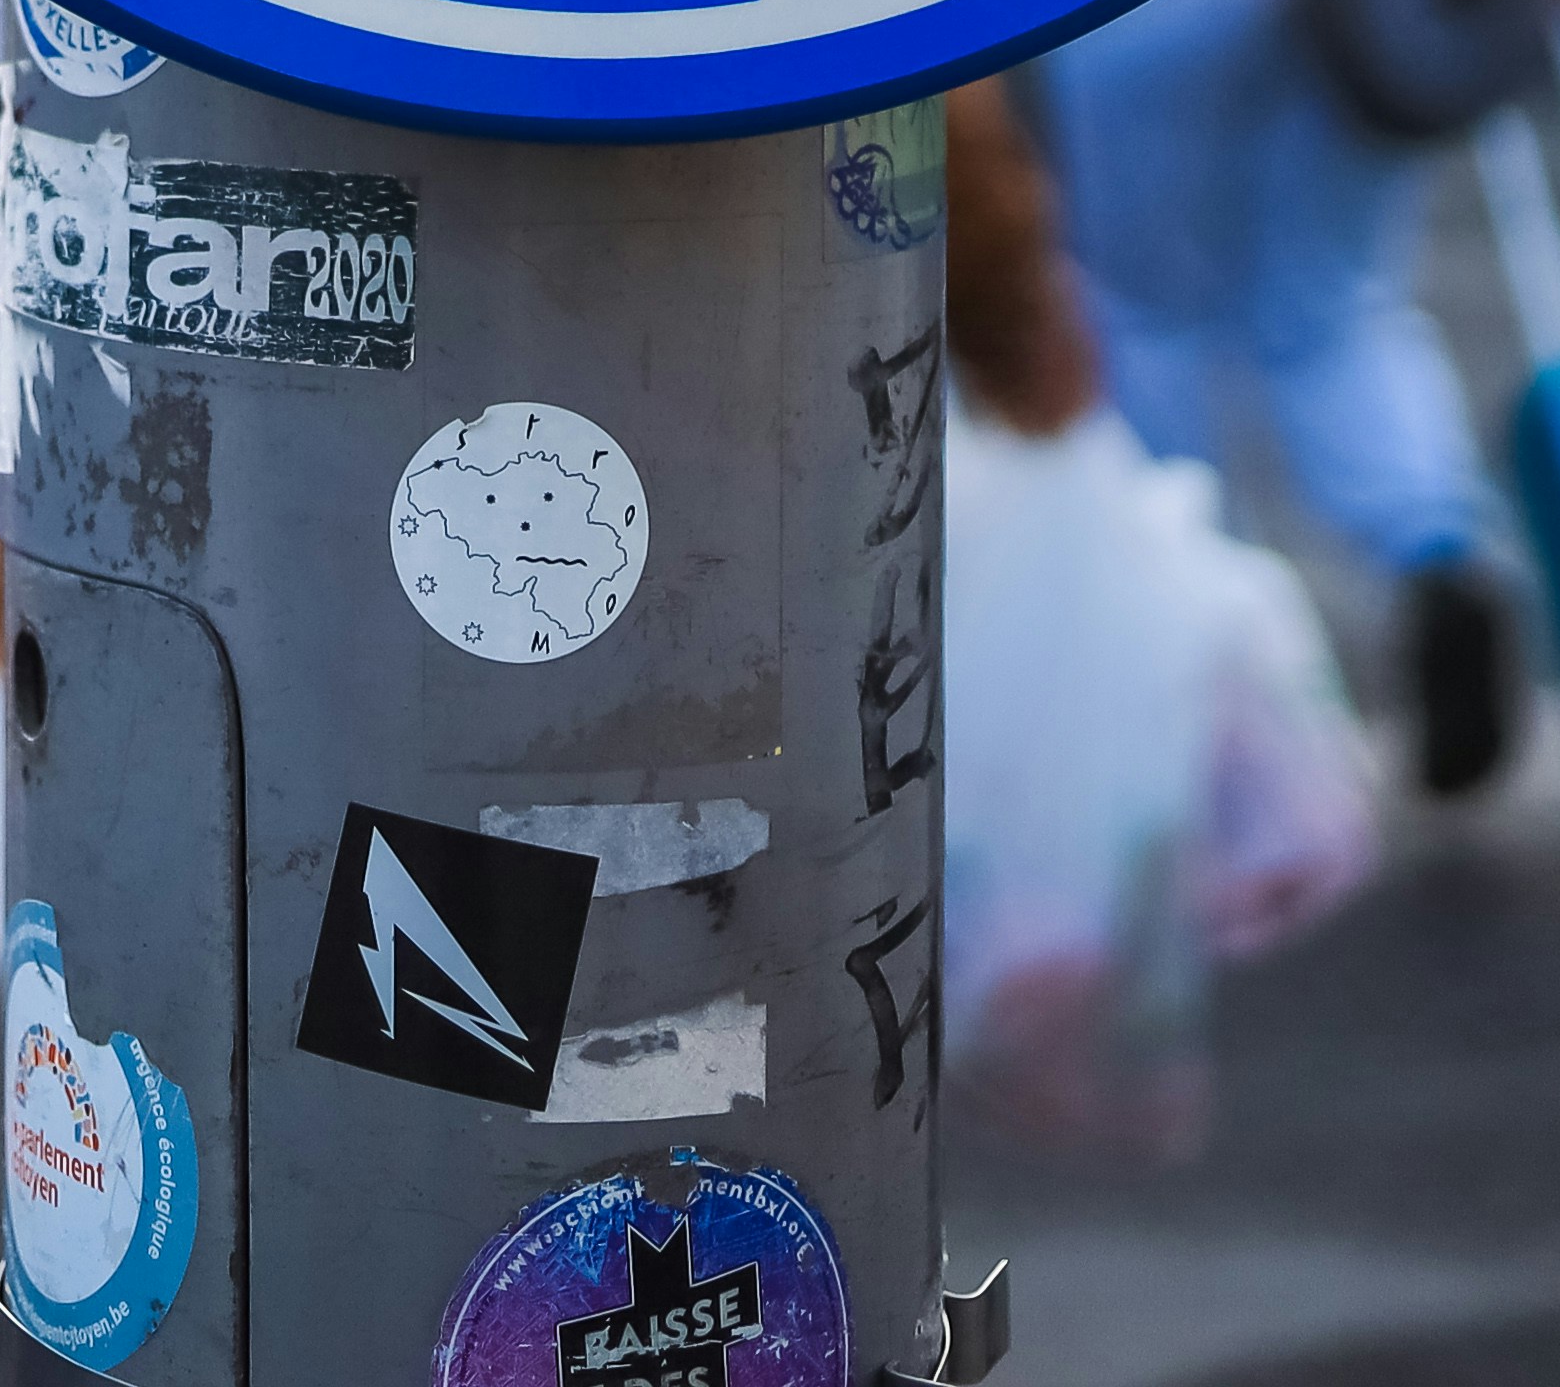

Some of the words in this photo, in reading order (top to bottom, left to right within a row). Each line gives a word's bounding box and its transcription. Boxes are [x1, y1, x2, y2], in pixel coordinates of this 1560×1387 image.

[304, 230, 415, 324] 2020
[130, 1038, 168, 1131] urgence
[147, 1136, 177, 1260] écologique
